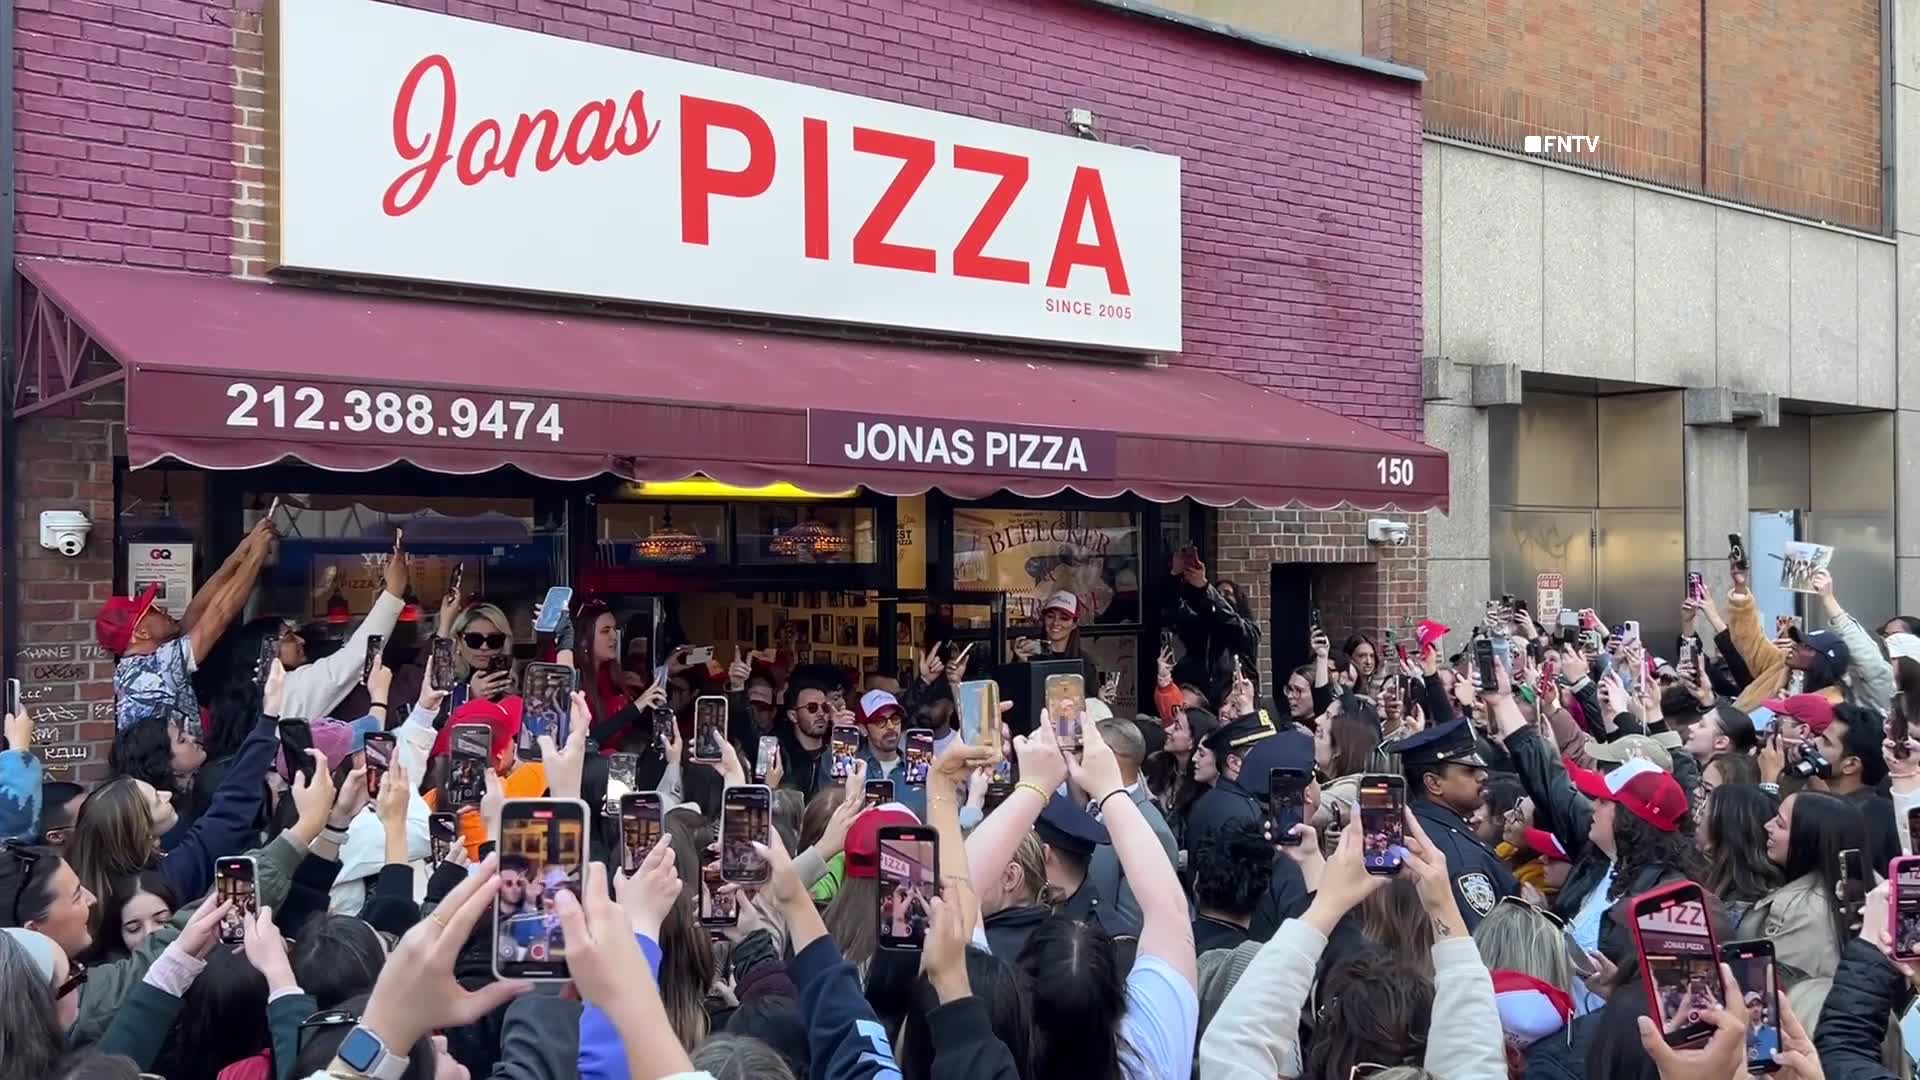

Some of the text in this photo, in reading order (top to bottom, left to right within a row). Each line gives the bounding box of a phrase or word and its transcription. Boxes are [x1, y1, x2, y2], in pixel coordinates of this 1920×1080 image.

[382, 54, 1131, 296] Jonas PIZZA
[1045, 298, 1133, 320] SINCE 2005
[226, 382, 564, 441] 212.388.9474
[844, 422, 1088, 472] JONAS PIZZA
[1377, 457, 1414, 486] 150
[150, 548, 172, 560] GQ
[987, 519, 1111, 555] BLEECKER
